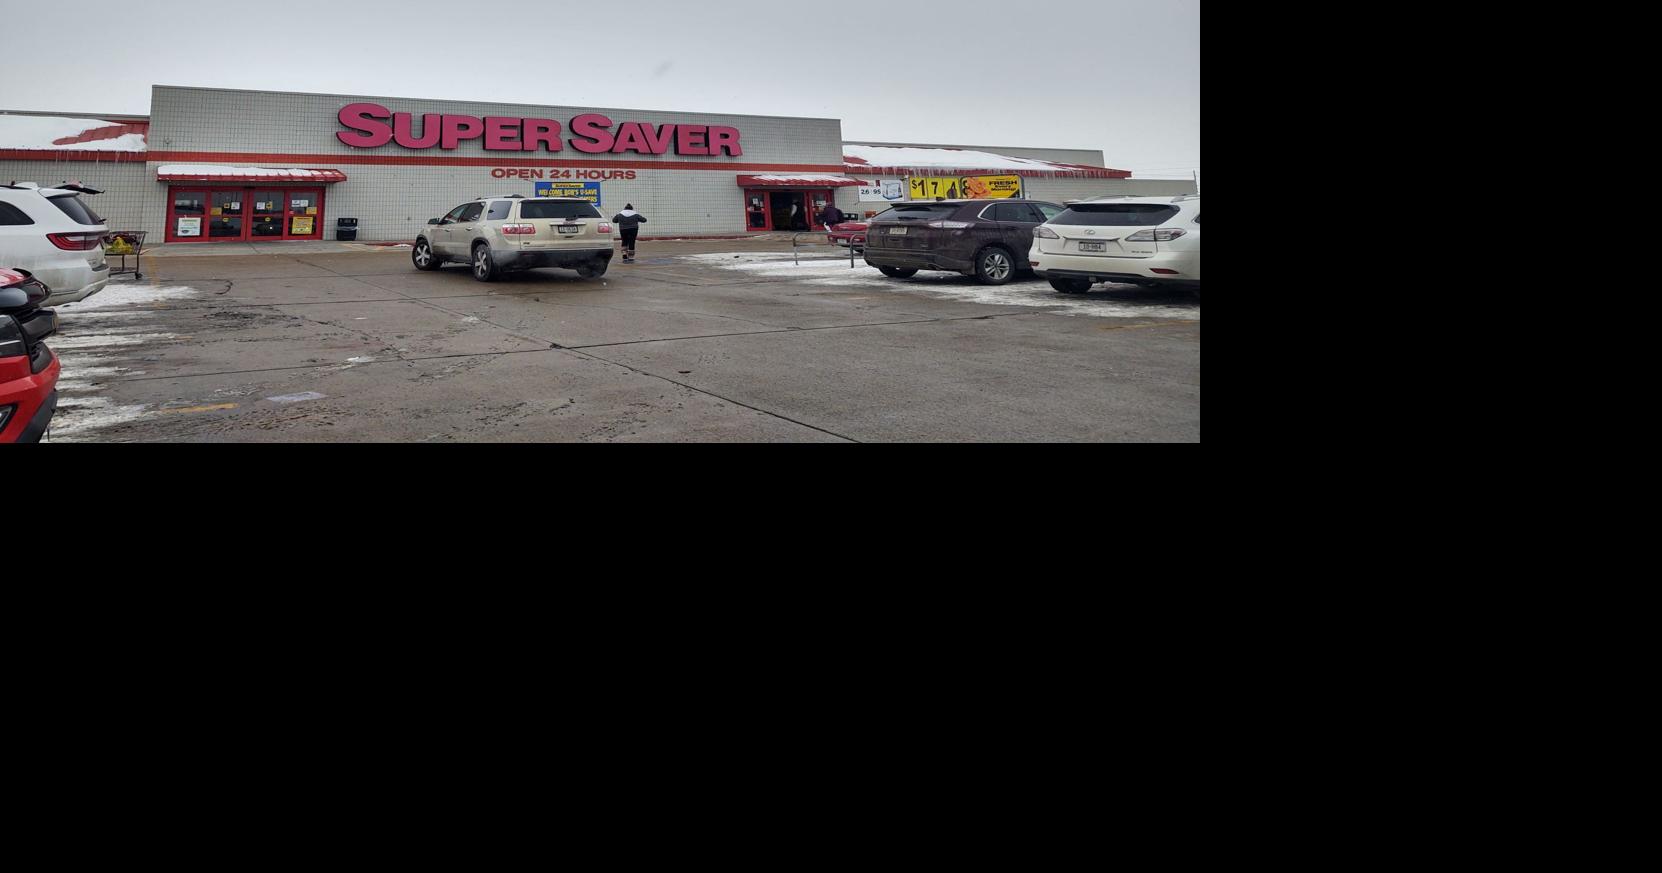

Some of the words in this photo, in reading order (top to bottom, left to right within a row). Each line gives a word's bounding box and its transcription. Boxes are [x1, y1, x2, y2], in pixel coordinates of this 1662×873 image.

[336, 102, 563, 152] SUPER
[567, 113, 743, 156] SAVER
[491, 168, 543, 179] OPEN
[550, 169, 571, 179] 24
[575, 169, 636, 180] HOURS
